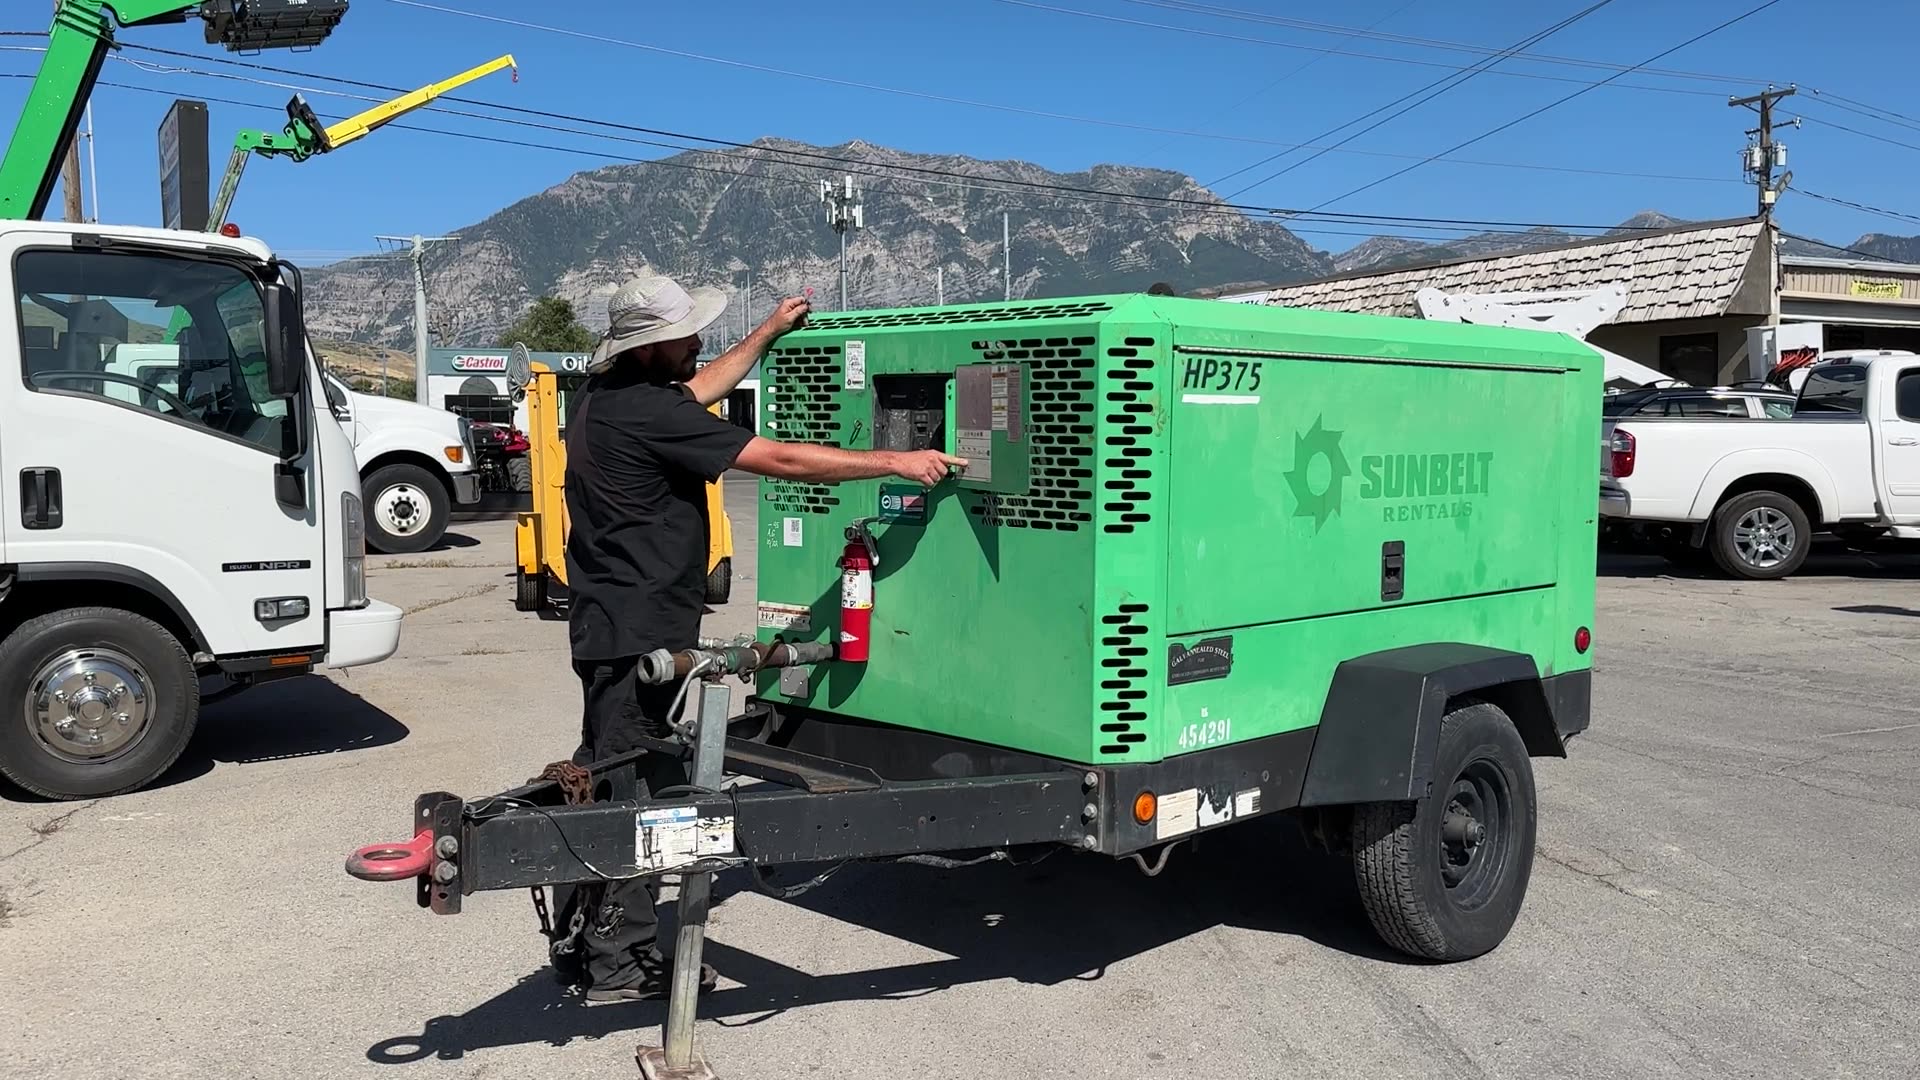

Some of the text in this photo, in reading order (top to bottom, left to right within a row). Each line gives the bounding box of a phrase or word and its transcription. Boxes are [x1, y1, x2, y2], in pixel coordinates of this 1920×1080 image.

[465, 356, 504, 369] Castrol
[1183, 358, 1262, 391] HP375
[1360, 451, 1494, 499] SUNBELT
[1383, 501, 1473, 522] RENTALS
[259, 561, 300, 570] NPR
[1214, 647, 1230, 660] STEEL
[1179, 718, 1231, 749] 454291
